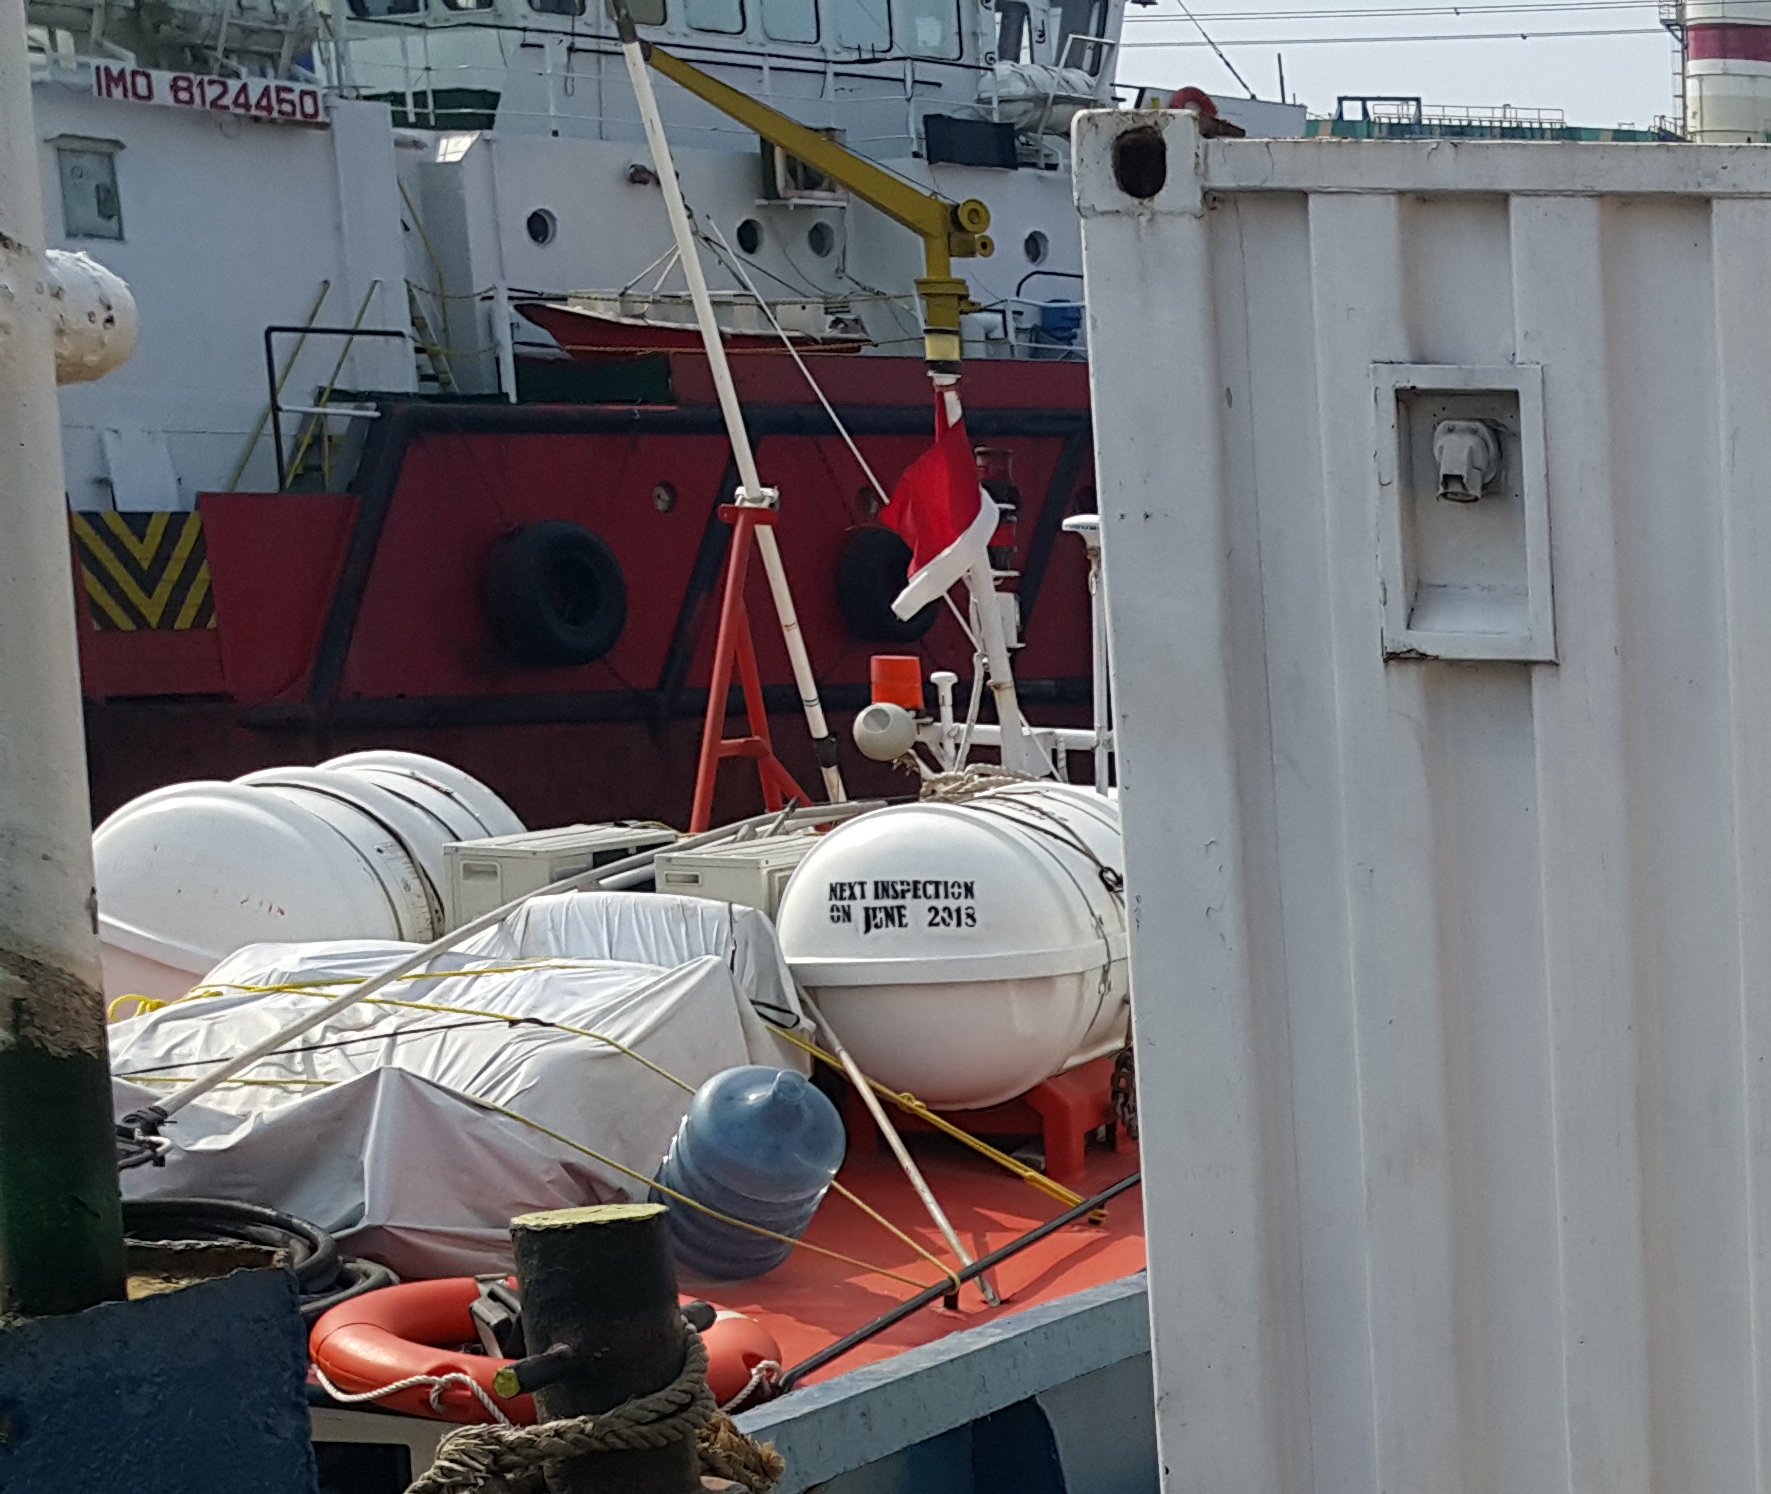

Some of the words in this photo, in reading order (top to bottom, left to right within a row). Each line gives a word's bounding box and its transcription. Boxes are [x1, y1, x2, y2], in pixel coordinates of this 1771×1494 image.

[95, 64, 154, 101] IMO
[170, 75, 320, 119] 8124450
[829, 881, 867, 901] NEXT
[873, 880, 975, 900] INSPECTION
[829, 904, 852, 923] ON
[863, 905, 908, 934] JUNE
[927, 906, 977, 928] 2018
